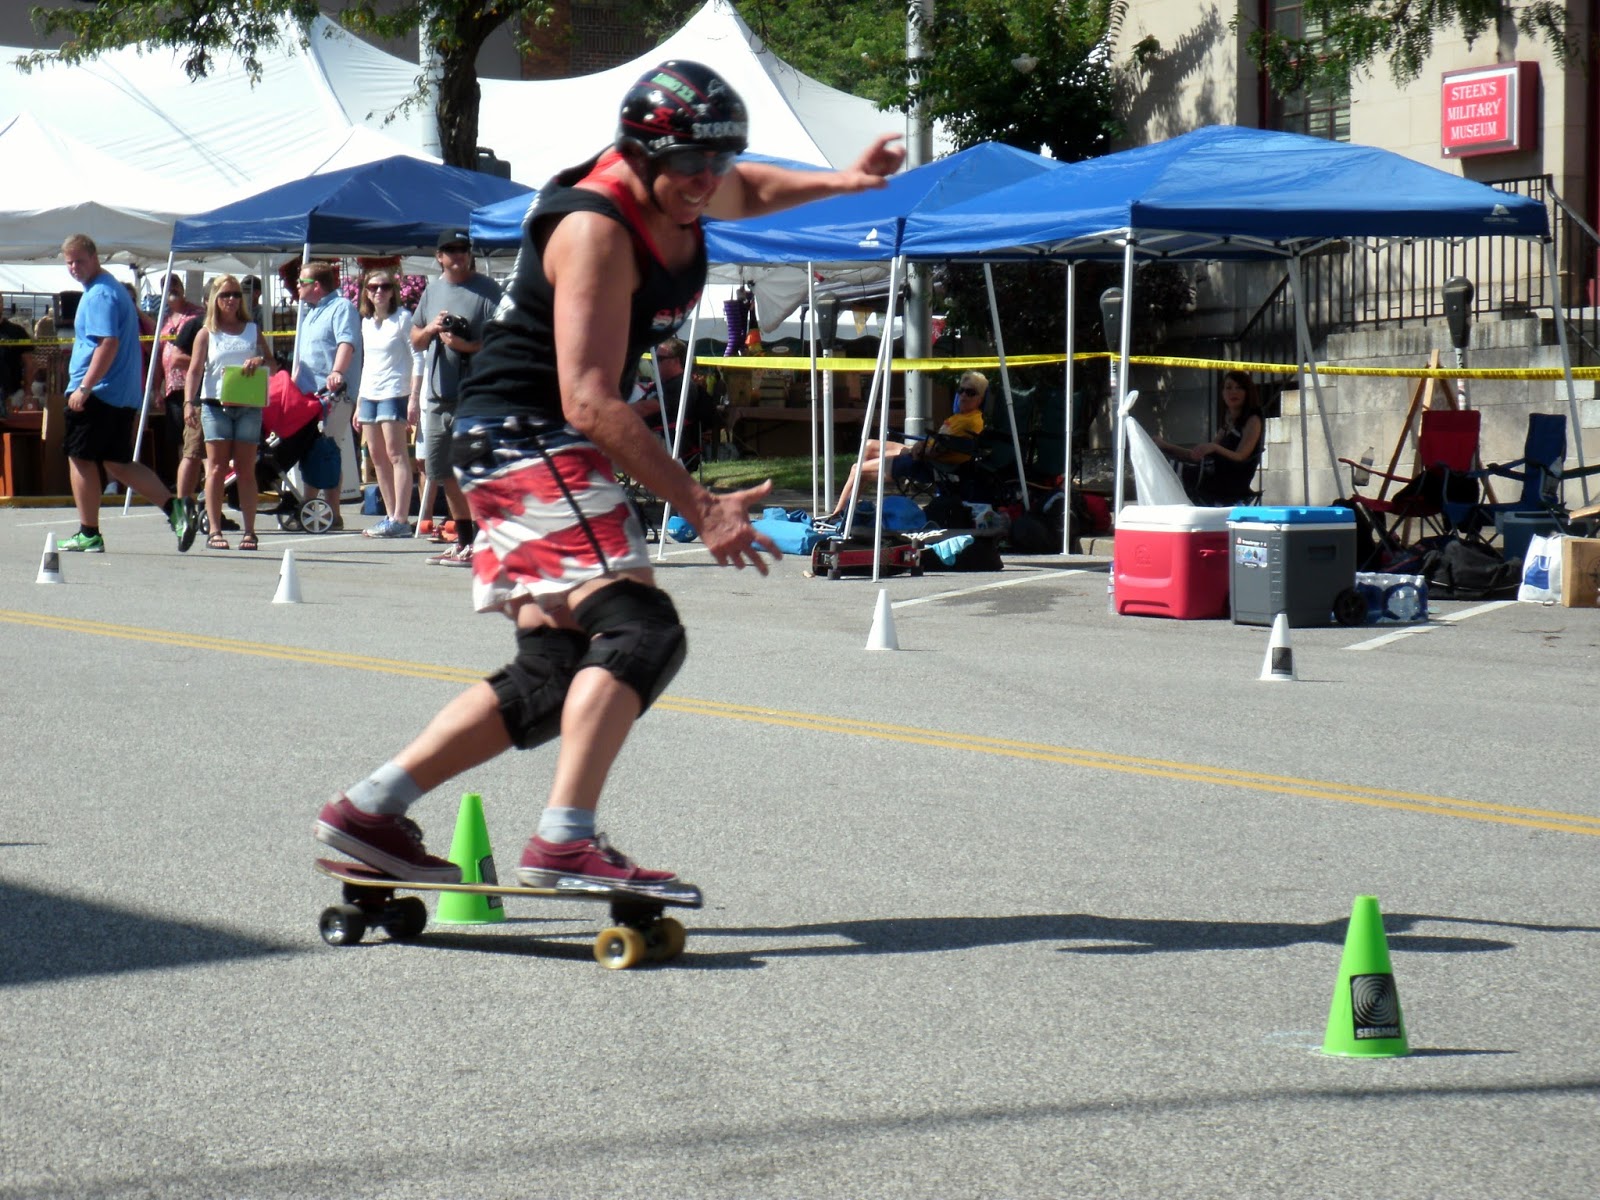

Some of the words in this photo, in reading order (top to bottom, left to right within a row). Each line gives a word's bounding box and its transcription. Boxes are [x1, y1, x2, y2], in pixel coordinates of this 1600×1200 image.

[1451, 81, 1497, 101] STEEN'S
[1447, 97, 1502, 121] MILITARY
[1450, 121, 1497, 140] MUSEUM
